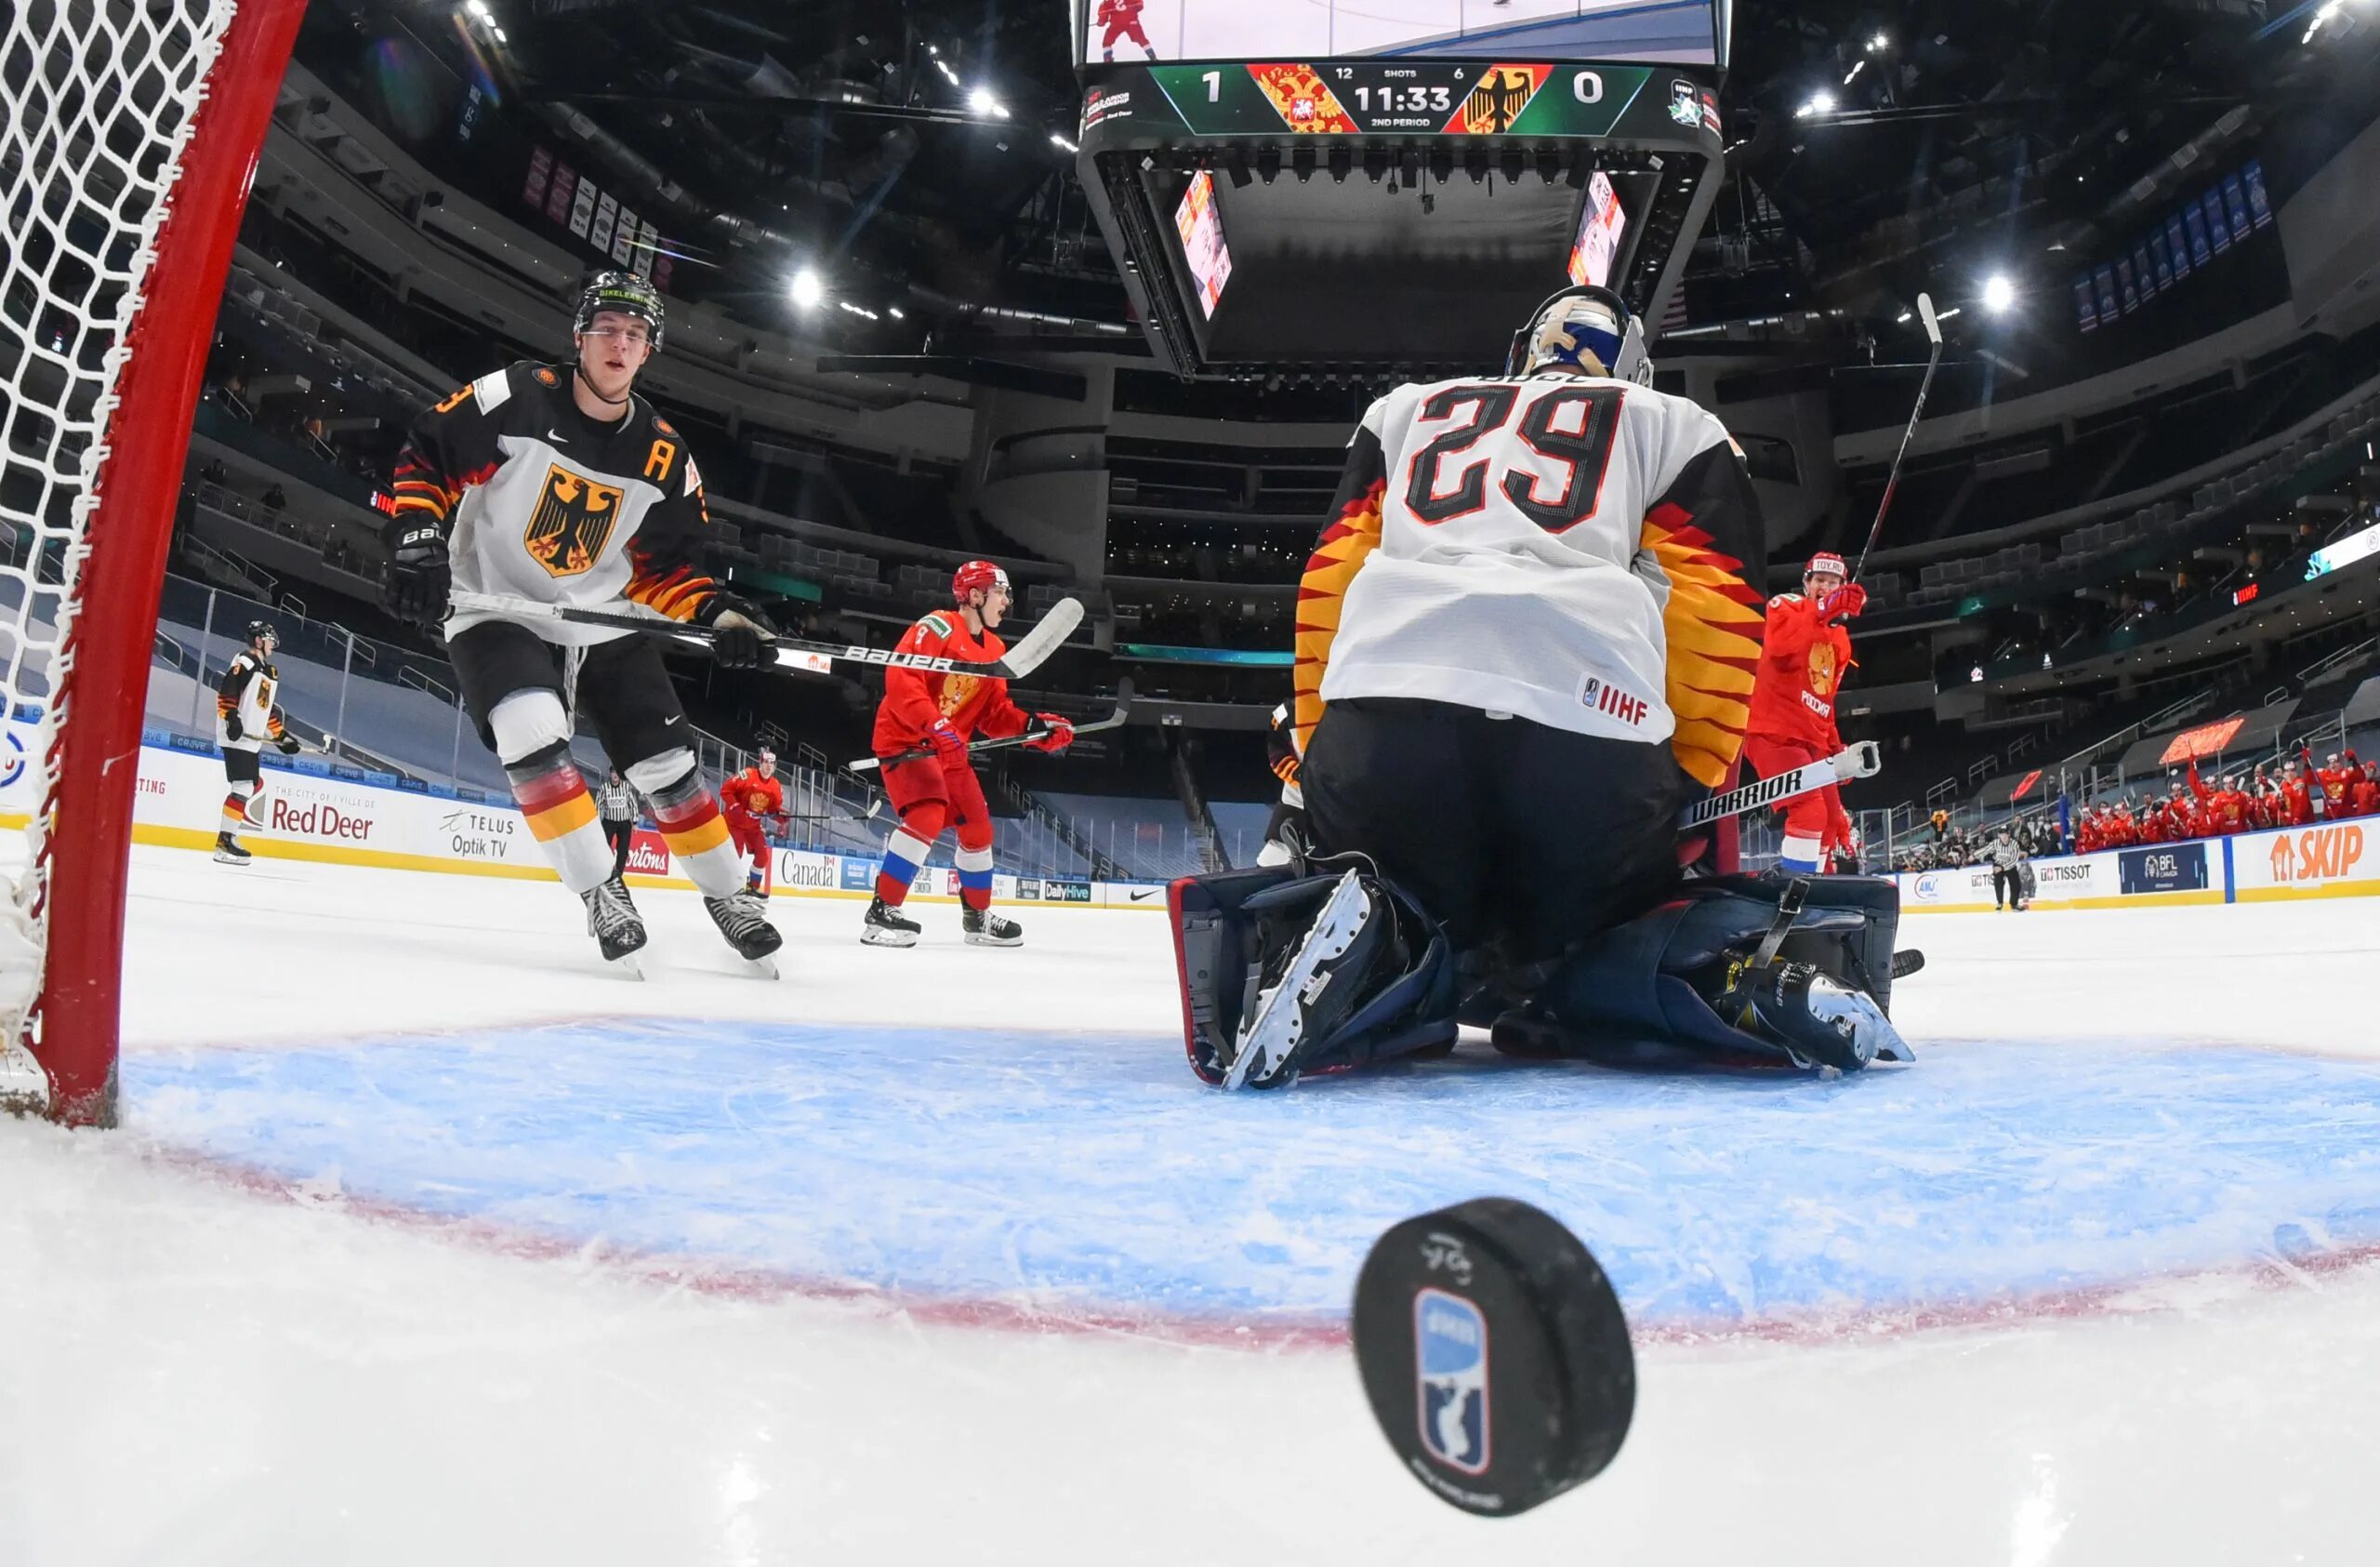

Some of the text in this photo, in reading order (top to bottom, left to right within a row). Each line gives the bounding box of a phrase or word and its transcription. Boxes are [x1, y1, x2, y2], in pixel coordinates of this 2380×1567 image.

[1202, 71, 1220, 102] 1
[1336, 68, 1353, 79] 12
[1383, 70, 1417, 78] SHOTS
[1453, 68, 1464, 79] 6
[1355, 86, 1450, 112] 11:33
[1573, 71, 1603, 104] 0
[1371, 118, 1431, 127] 2ND PERIOD
[643, 439, 677, 482] A
[1403, 385, 1628, 535] 29
[845, 646, 954, 671] BAUER
[1599, 684, 1647, 725] IIHF
[138, 778, 165, 794] TING
[1692, 770, 1803, 822] WARRIOR
[272, 798, 374, 840] Red Deer
[469, 815, 514, 834] TELUS
[452, 834, 507, 857] Optik TV
[626, 842, 666, 870] ortons
[2296, 825, 2364, 880] SKIP
[782, 850, 834, 887] Canada
[2055, 864, 2091, 880] TISSOT
[2160, 855, 2178, 871] BFL
